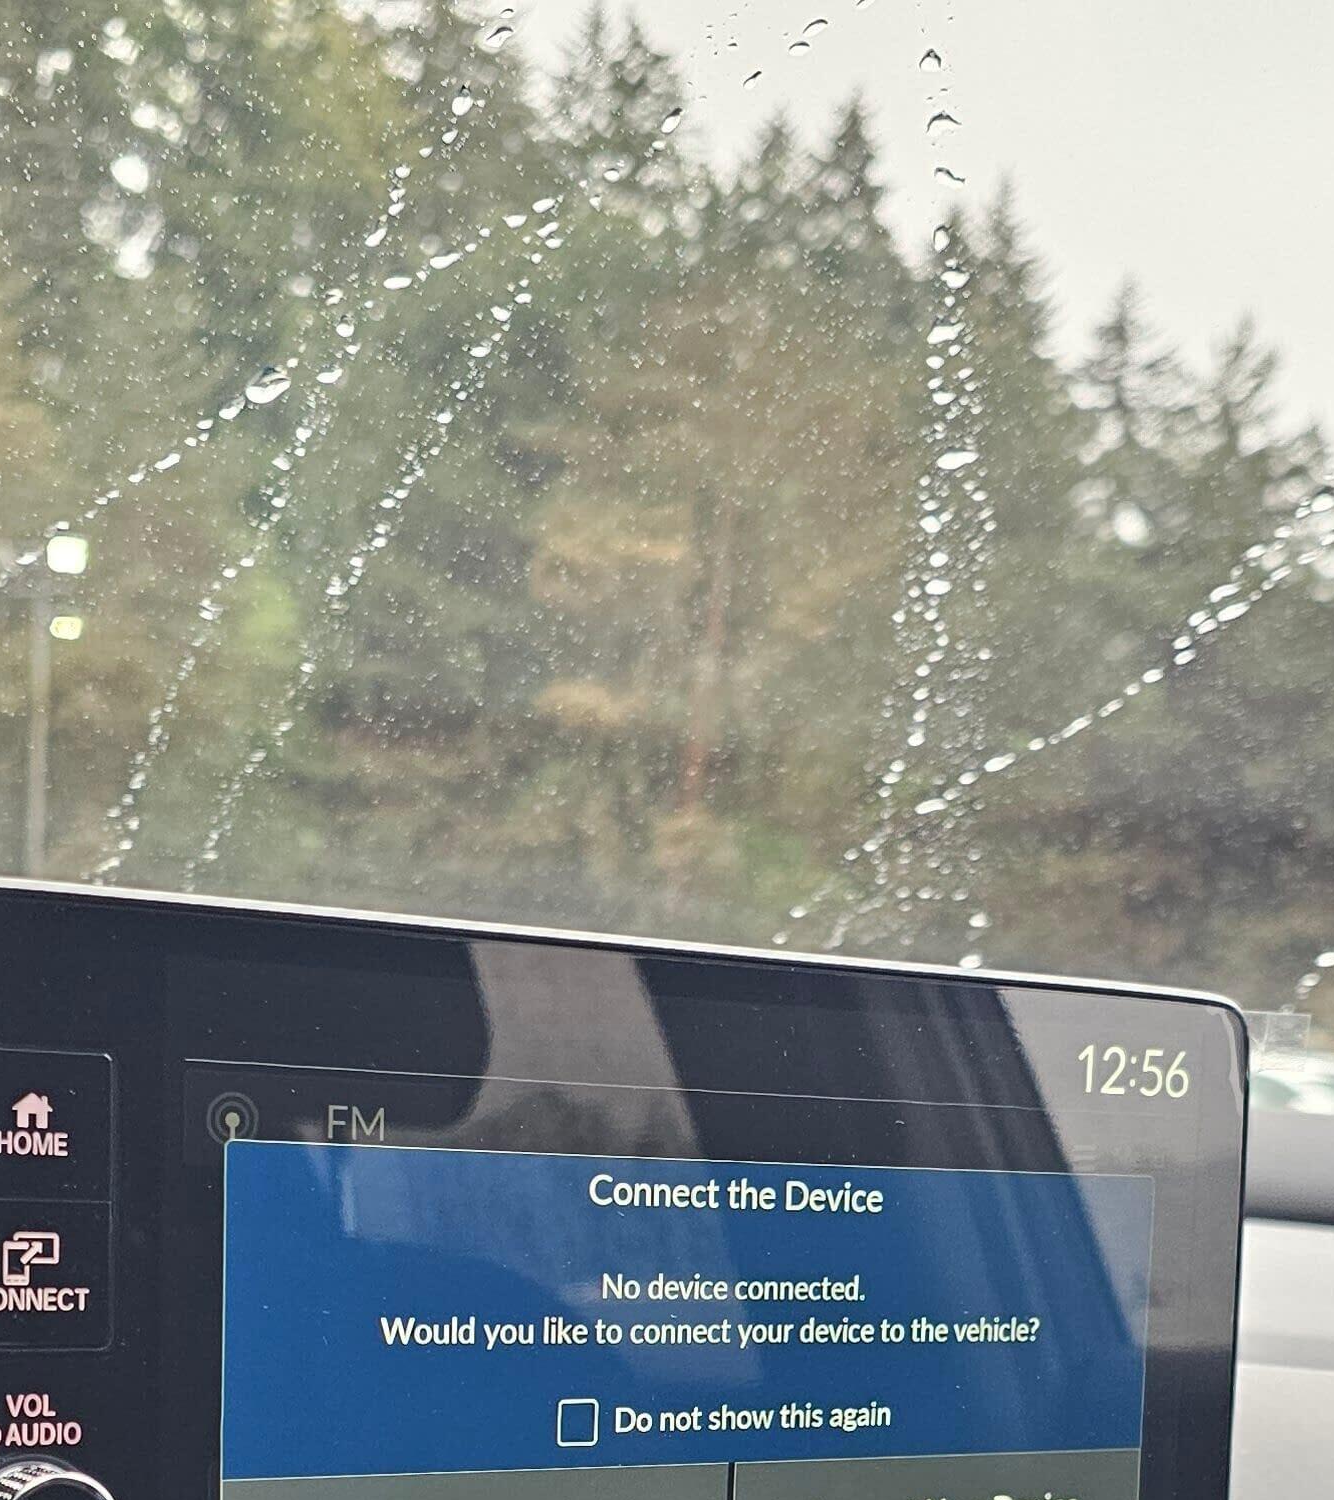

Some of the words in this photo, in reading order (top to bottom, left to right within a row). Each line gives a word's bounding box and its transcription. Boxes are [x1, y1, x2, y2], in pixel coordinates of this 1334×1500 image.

[1078, 1044, 1189, 1098] 12:56
[327, 1105, 385, 1141] FM
[589, 1173, 720, 1209] Connect
[727, 1177, 777, 1210] the
[785, 1180, 884, 1213] Device
[602, 1272, 641, 1300] No
[647, 1272, 729, 1301] device
[734, 1274, 866, 1302] connected.
[380, 1316, 476, 1346] Would
[483, 1324, 534, 1351] you
[543, 1316, 589, 1345] like
[595, 1318, 623, 1345] to
[629, 1318, 732, 1345] connect
[738, 1323, 795, 1349] your
[799, 1316, 875, 1343] device
[880, 1318, 905, 1343] to
[910, 1316, 949, 1343] the
[953, 1316, 1041, 1343] vehicle?
[5, 1393, 57, 1418] VOL
[615, 1406, 653, 1434] Do
[659, 1406, 703, 1432] not
[708, 1404, 775, 1431] show
[779, 1402, 824, 1429] this
[829, 1401, 892, 1432] again
[4, 1421, 82, 1447] AUDIO
